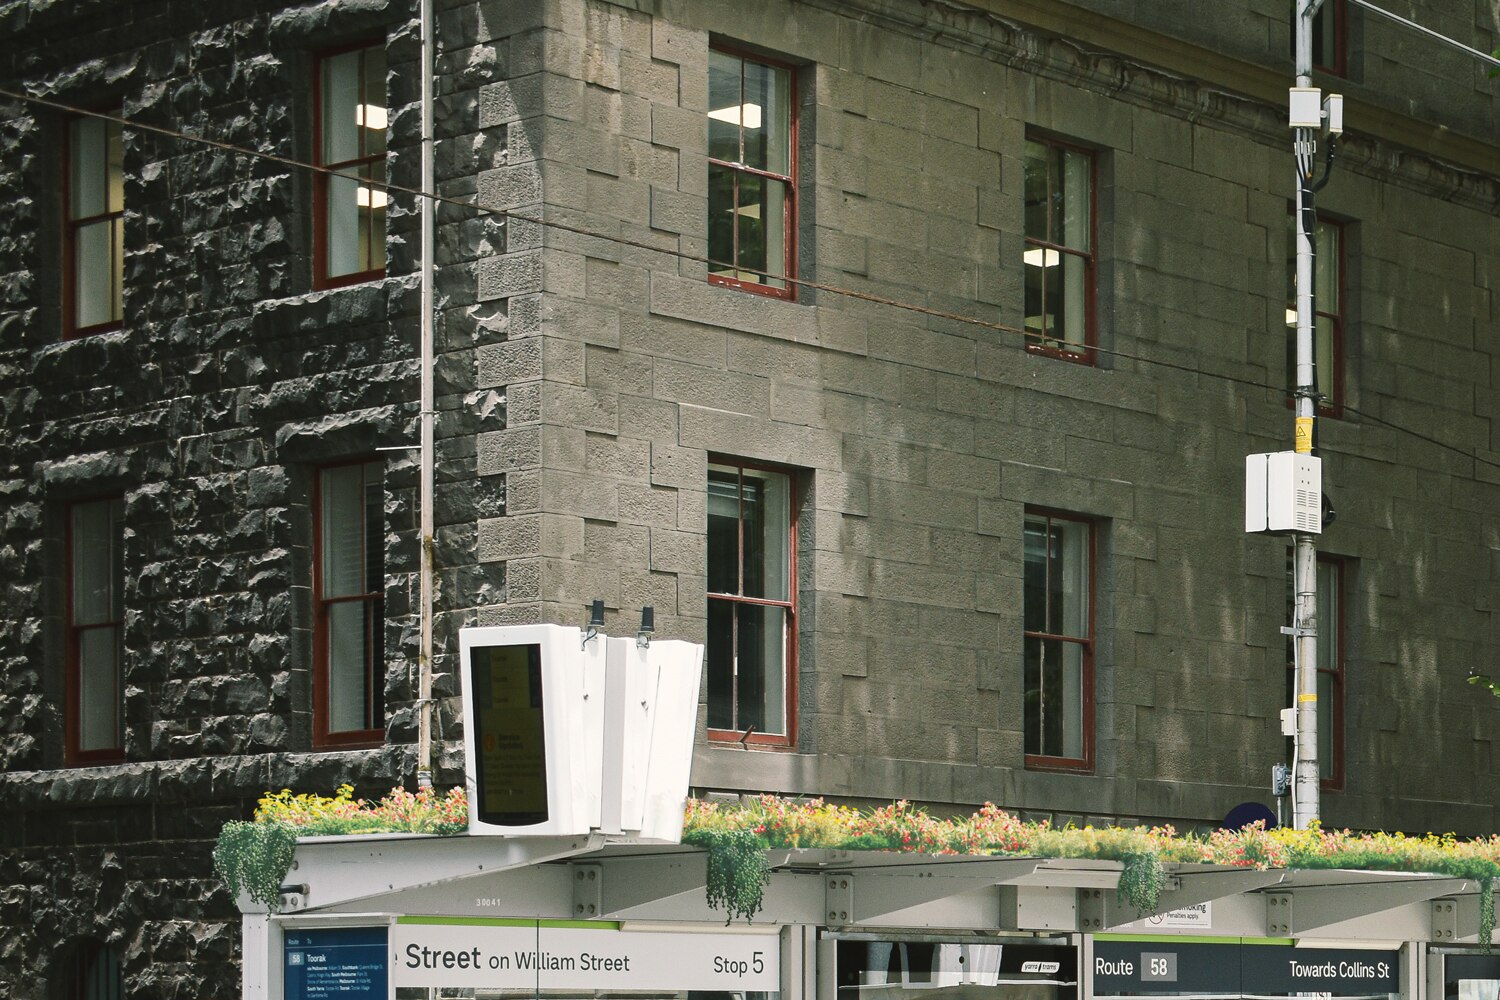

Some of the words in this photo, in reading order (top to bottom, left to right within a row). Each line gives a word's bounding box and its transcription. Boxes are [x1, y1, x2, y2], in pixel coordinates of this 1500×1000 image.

[476, 898, 501, 907] 30041
[306, 954, 327, 962] Toorak
[406, 943, 481, 969] Street
[488, 954, 510, 970] on
[515, 952, 575, 971] William
[580, 953, 630, 971] Street
[713, 956, 748, 977] Stop
[752, 951, 764, 974] 5
[1095, 957, 1134, 976] Route
[1150, 958, 1168, 976] 58
[1289, 960, 1337, 978] Towards
[1339, 961, 1375, 978] Collins
[1377, 961, 1390, 978] St
